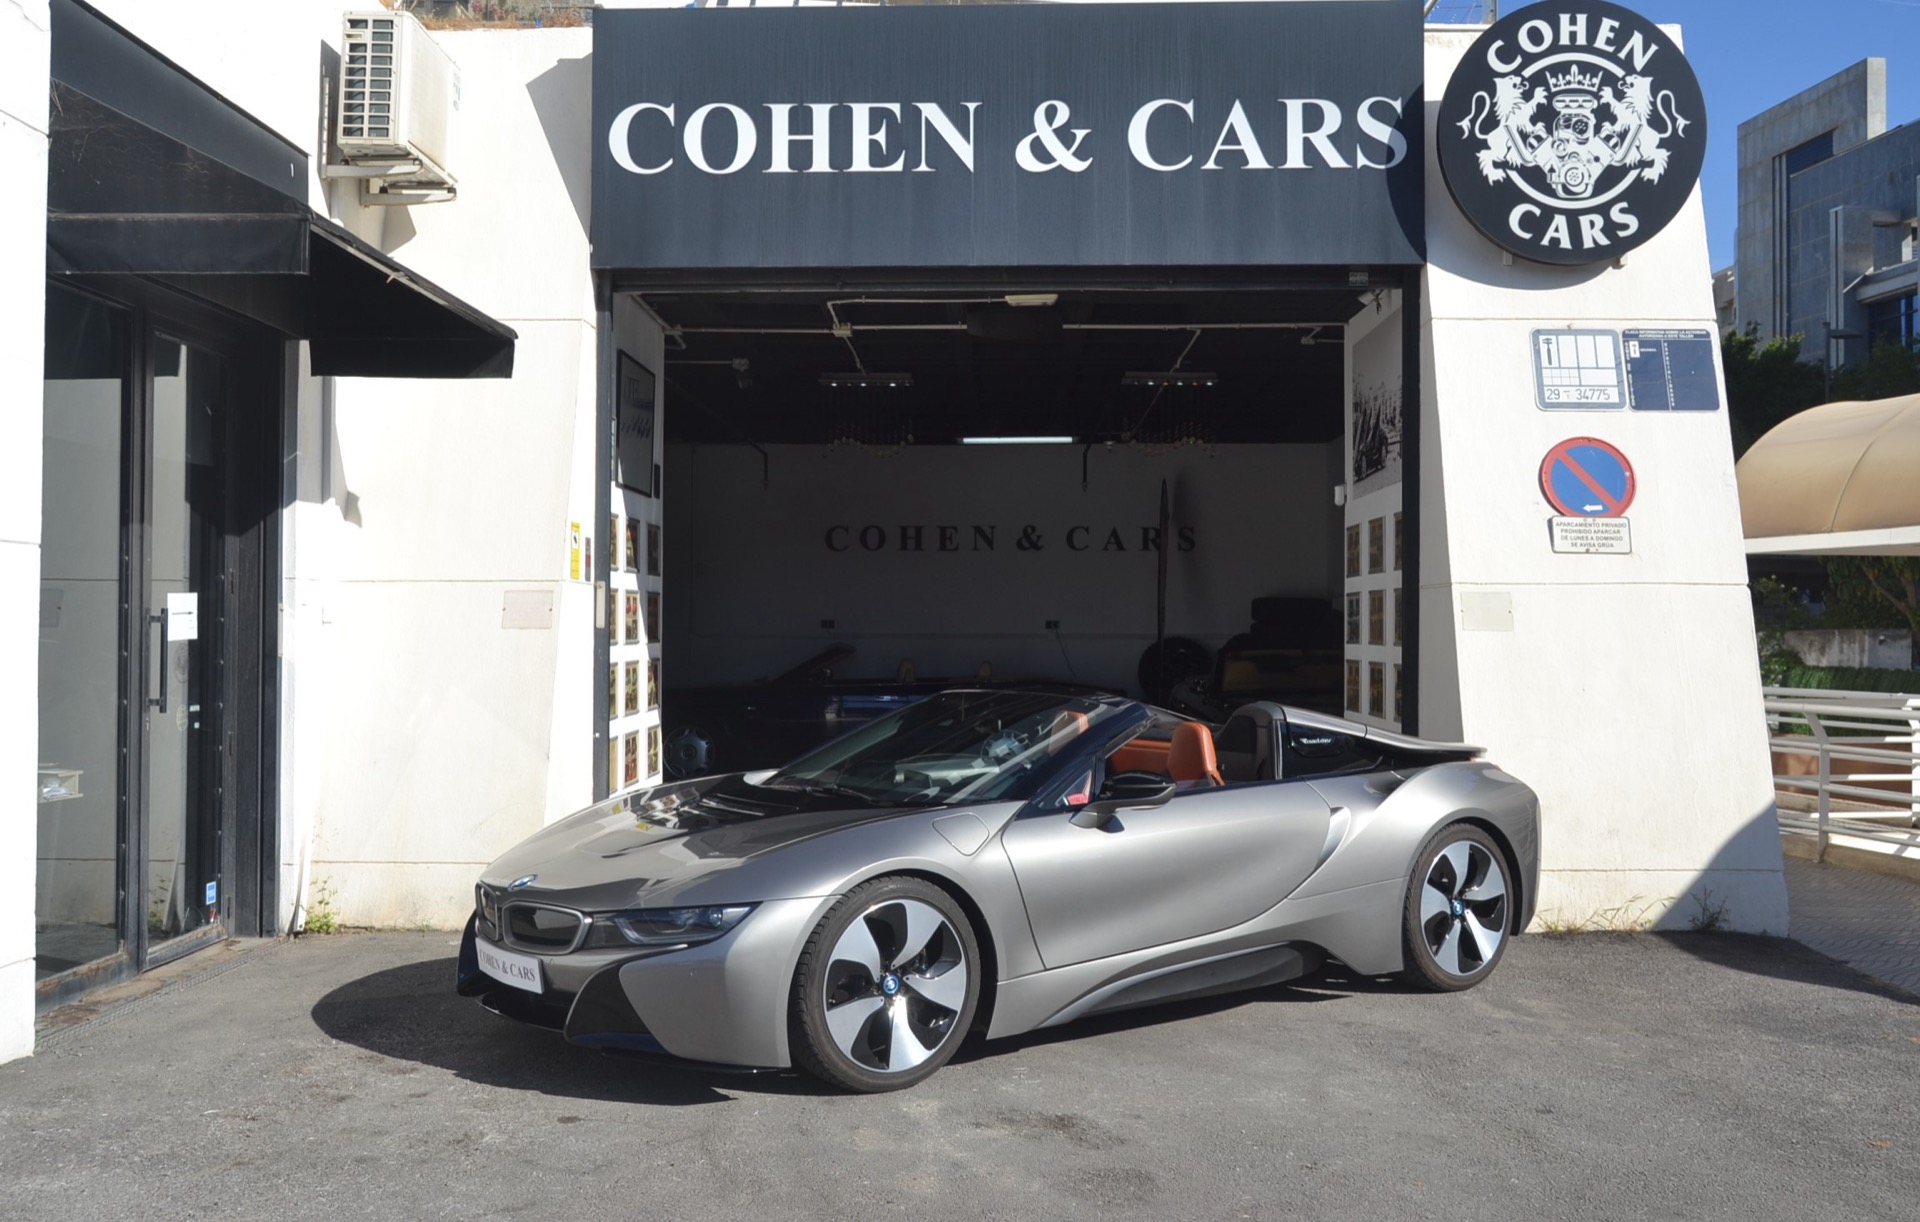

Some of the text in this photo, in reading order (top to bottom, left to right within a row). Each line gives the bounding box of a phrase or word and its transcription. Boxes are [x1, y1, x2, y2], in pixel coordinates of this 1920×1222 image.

[1487, 13, 1659, 73] COHEN
[608, 96, 1408, 175] COHEN & CARS
[1508, 201, 1639, 250] CARS
[1546, 388, 1560, 401] 29
[1575, 388, 1610, 401] 34775
[824, 524, 1196, 552] COHEN & CARS
[510, 962, 536, 982] CARS
